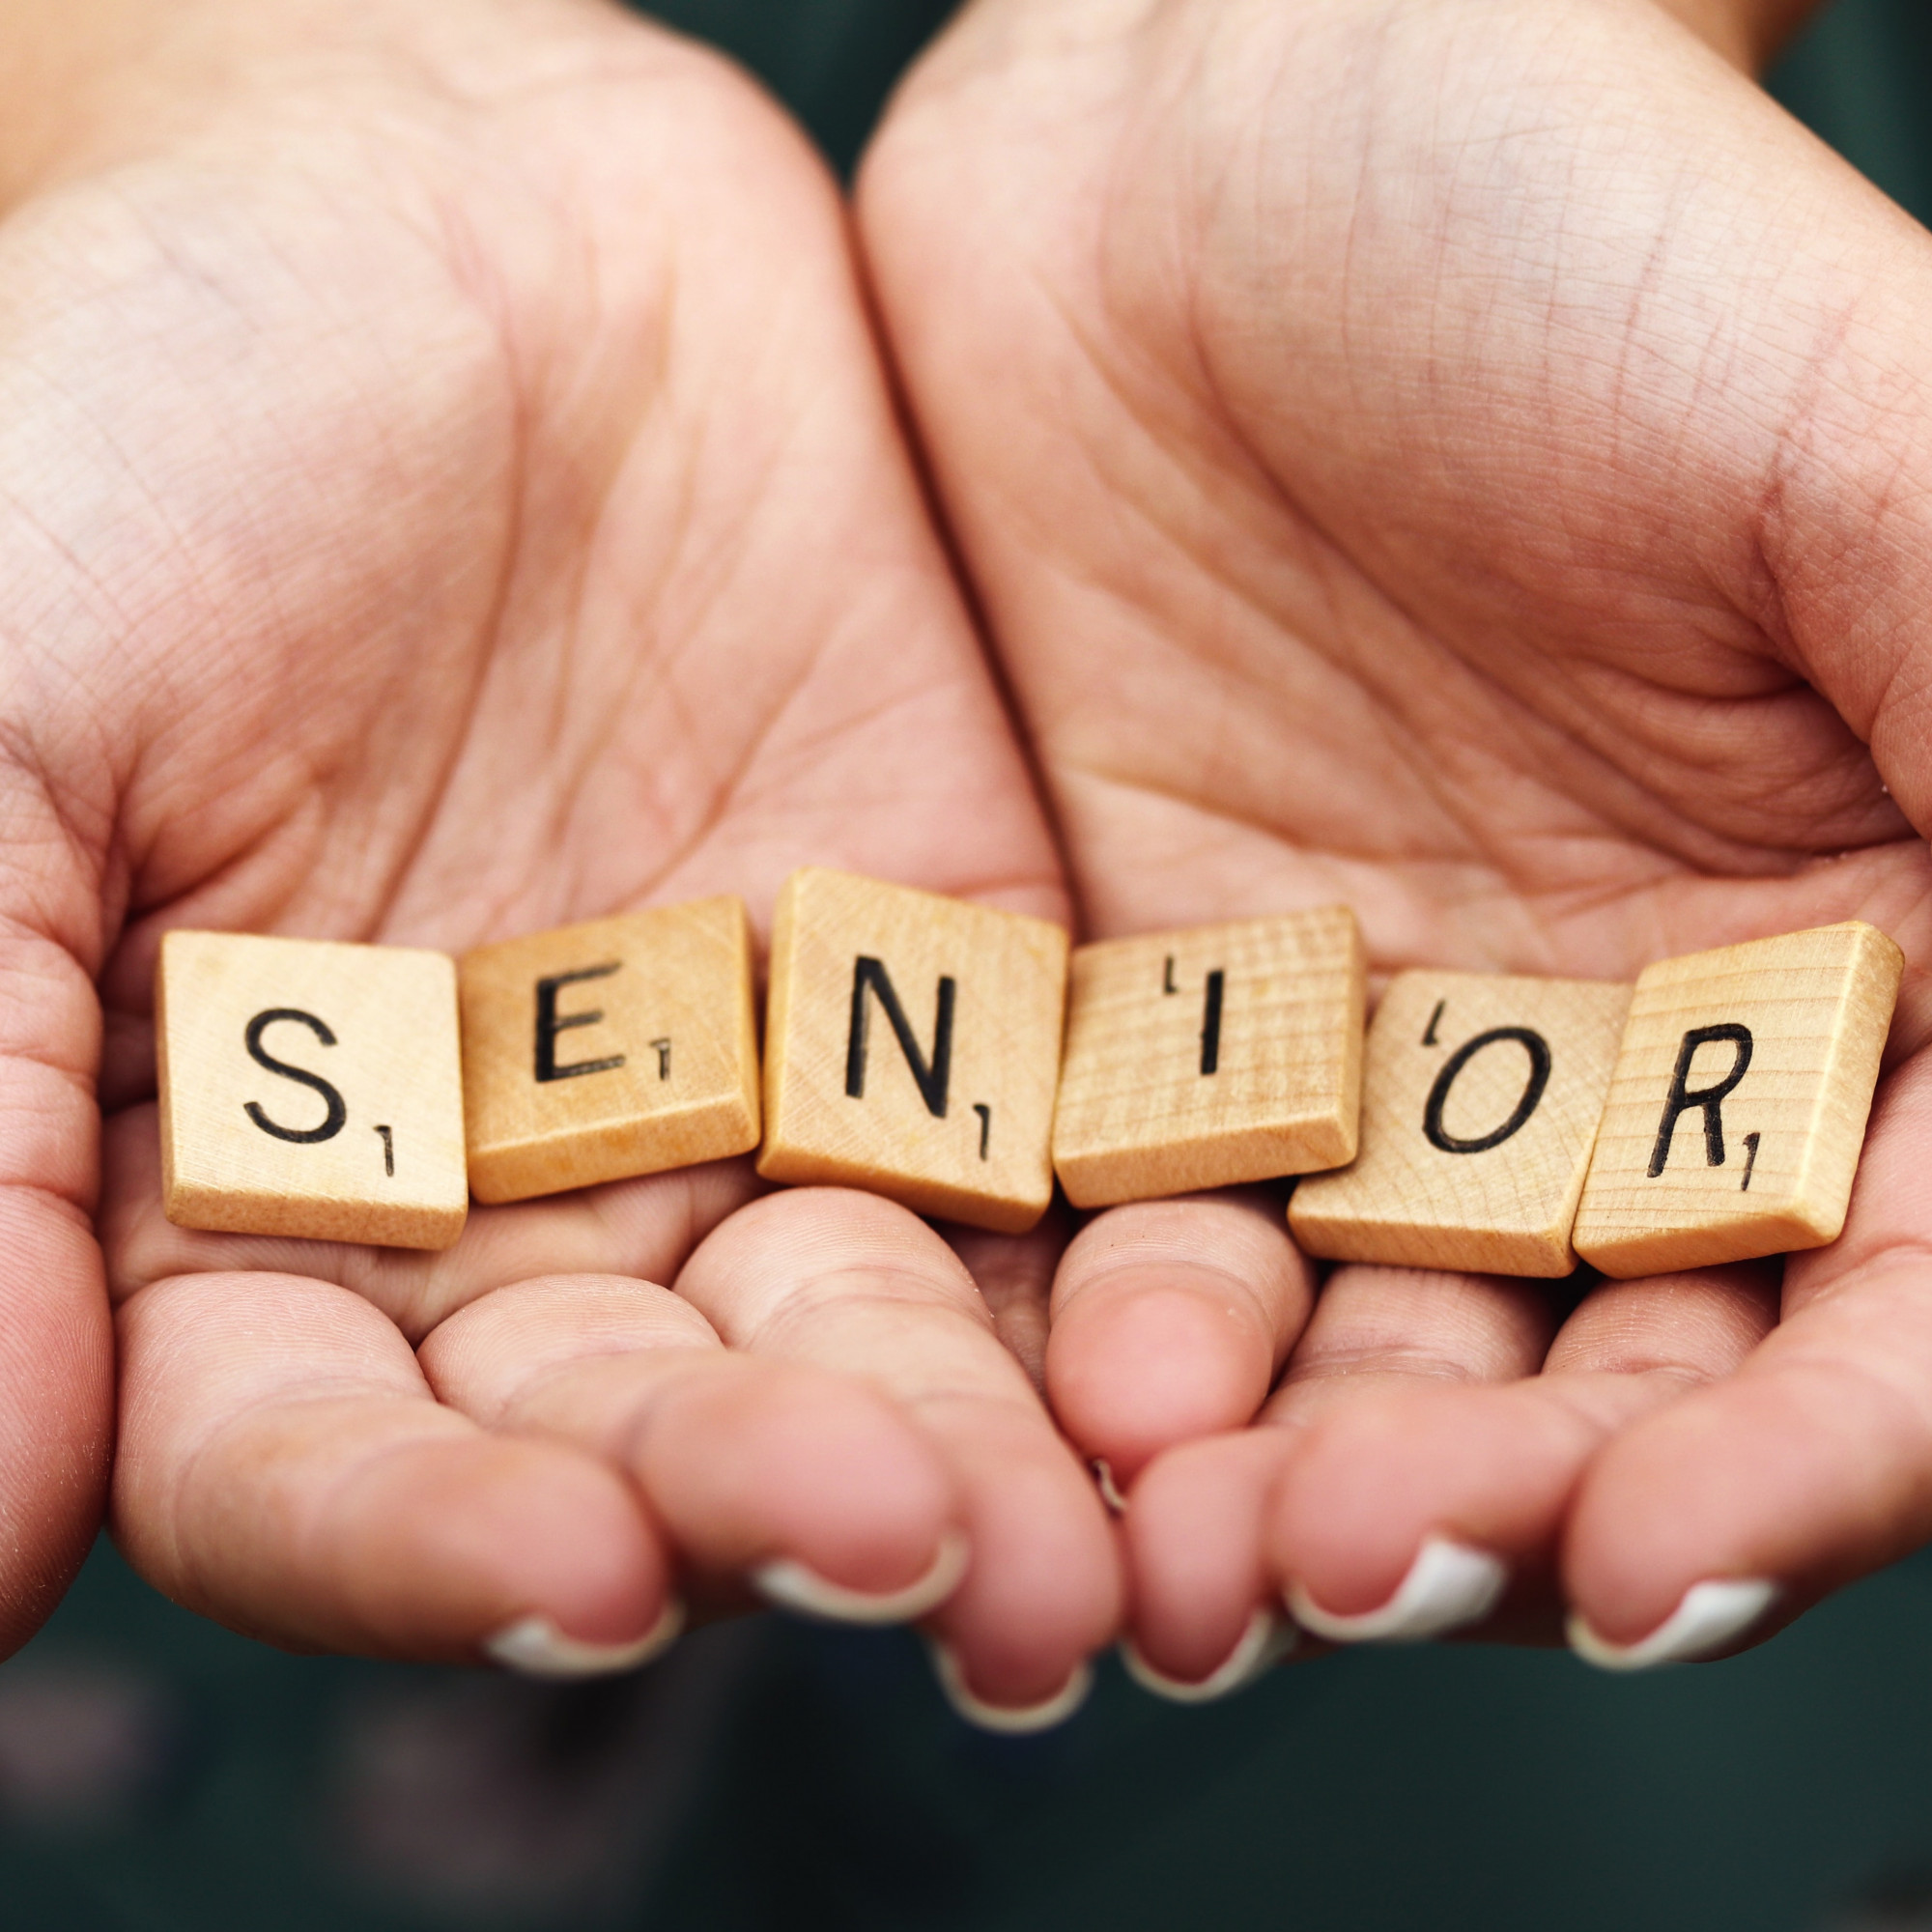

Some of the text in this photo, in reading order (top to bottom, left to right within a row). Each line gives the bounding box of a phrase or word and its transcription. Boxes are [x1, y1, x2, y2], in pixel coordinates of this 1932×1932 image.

[372, 1123, 395, 1176] 1
[972, 1103, 991, 1161] 1
[1740, 1132, 1761, 1192] 1
